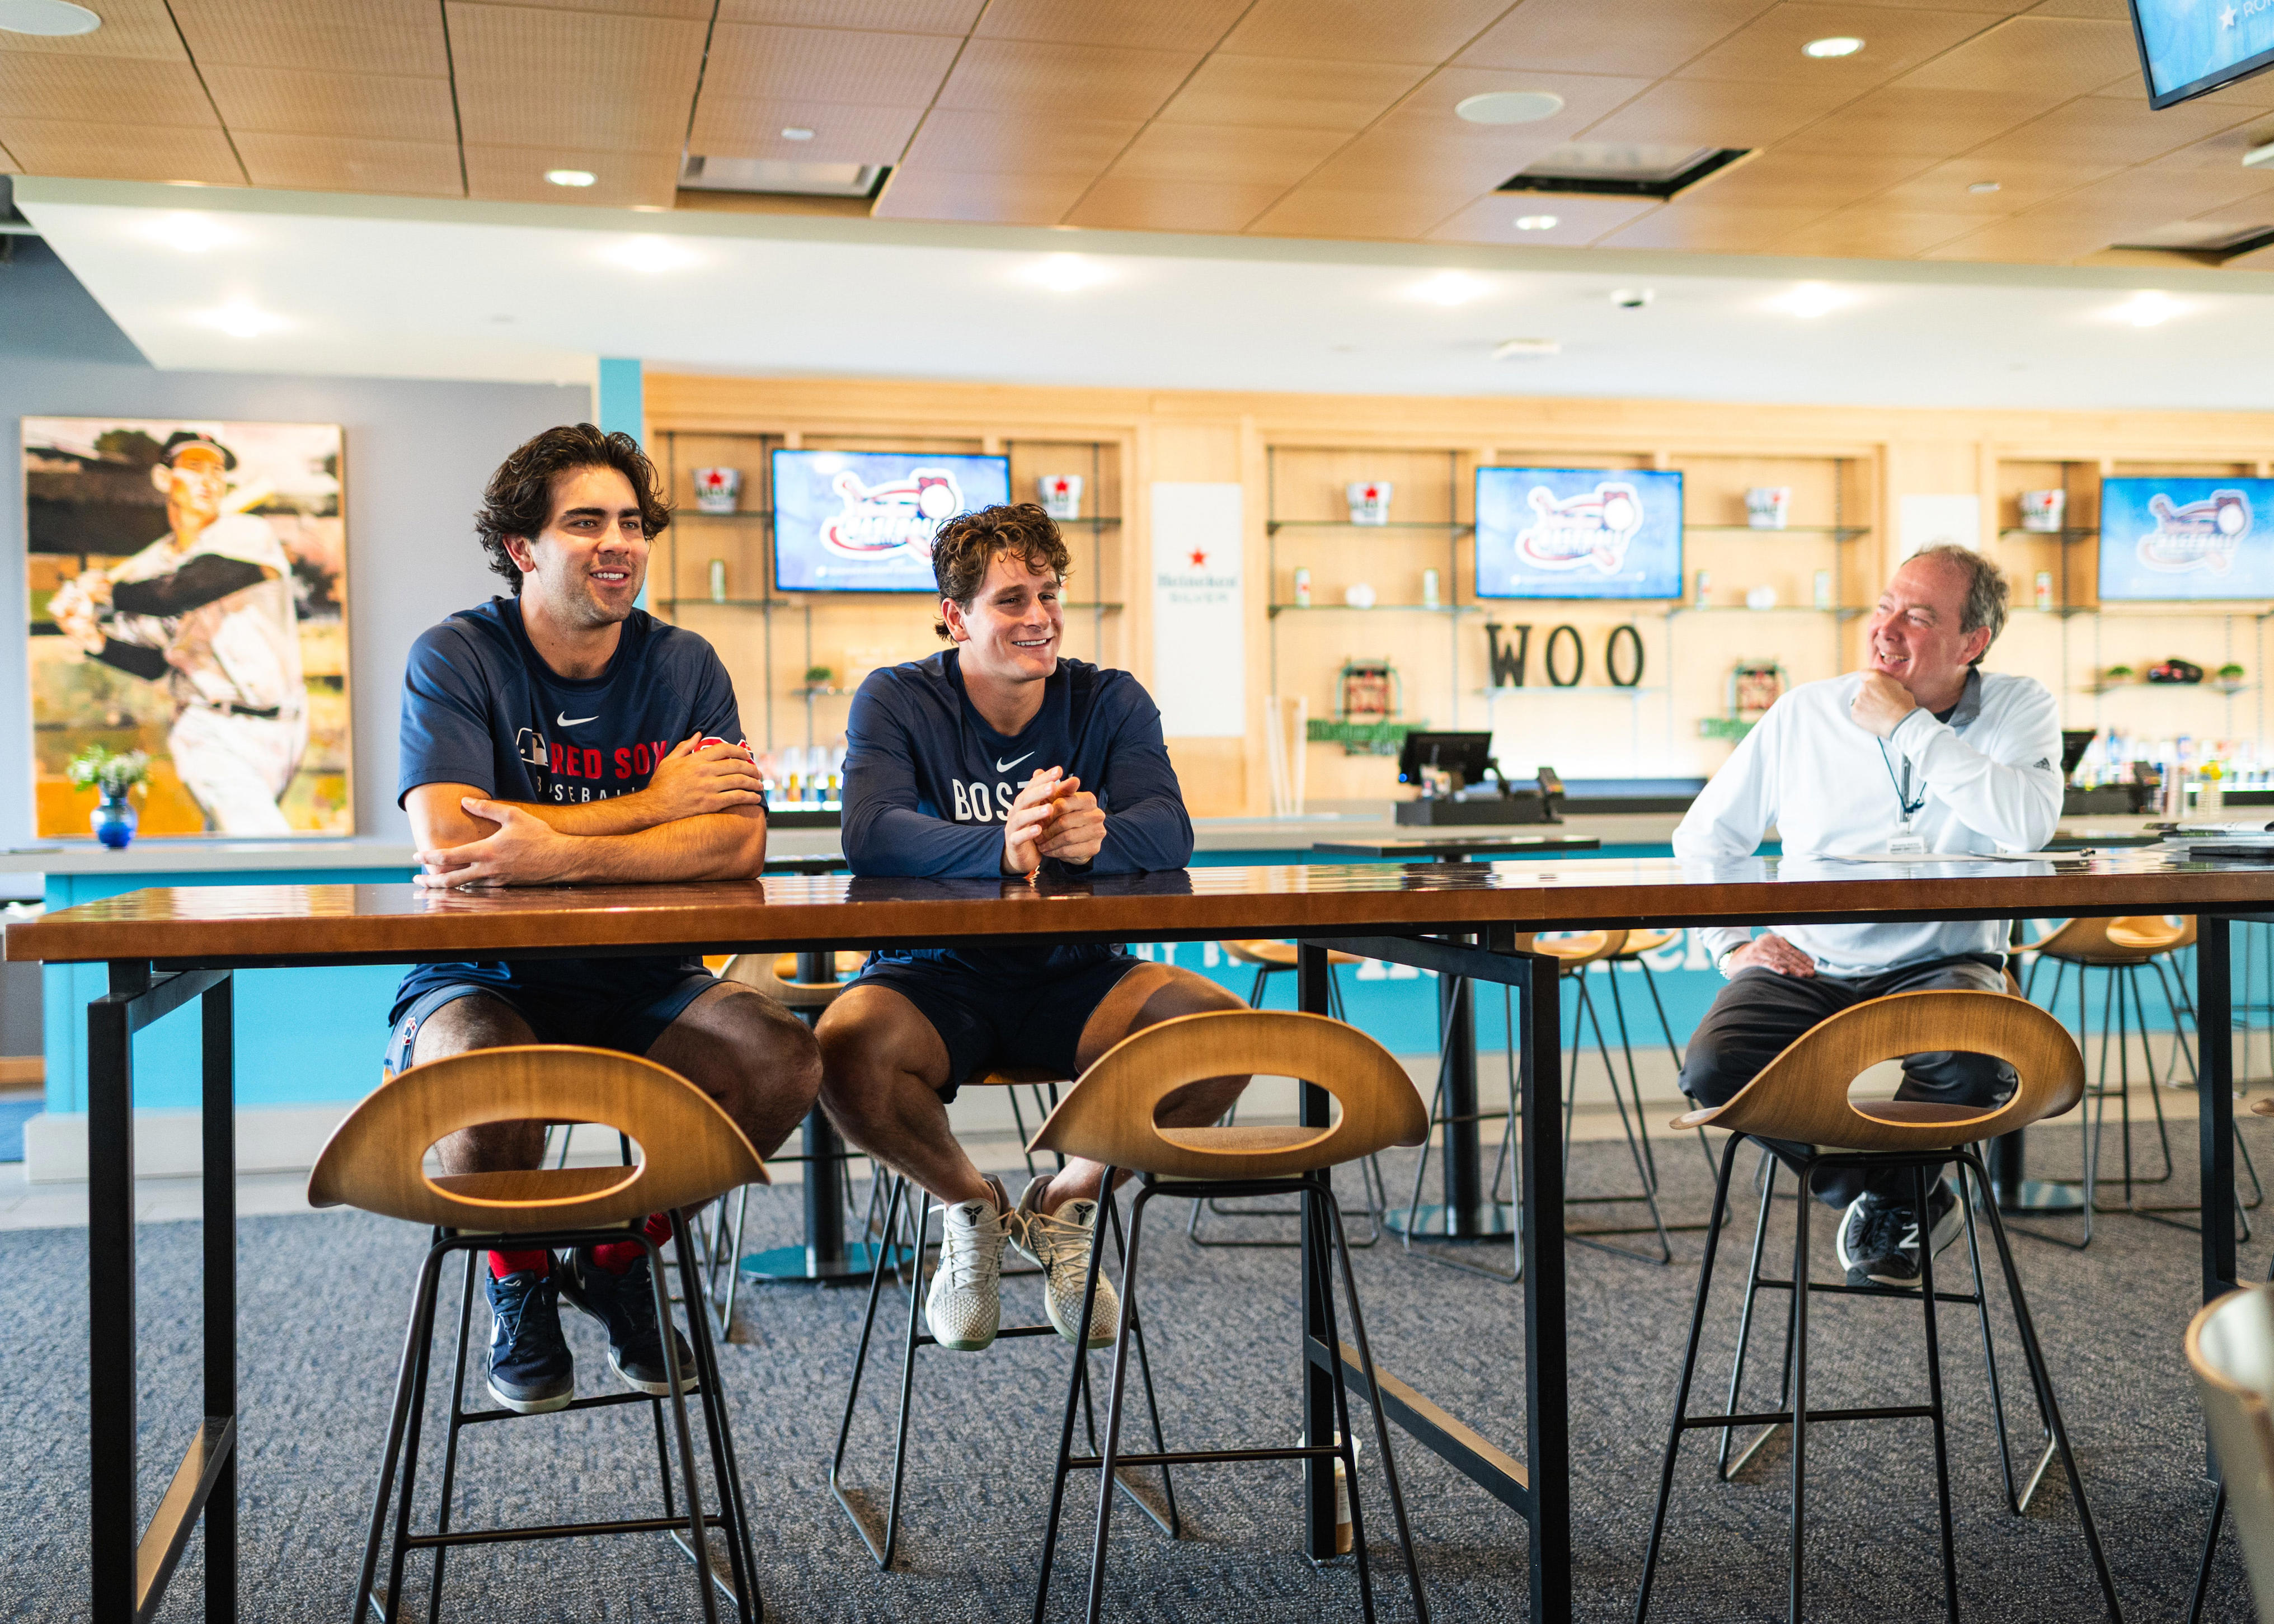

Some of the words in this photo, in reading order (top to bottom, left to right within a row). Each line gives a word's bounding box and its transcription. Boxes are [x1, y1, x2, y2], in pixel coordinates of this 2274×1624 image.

[1484, 623, 1645, 688] WOO
[550, 742, 603, 779] RED
[537, 776, 636, 803] BSEBA
[952, 773, 1074, 822] BOS
